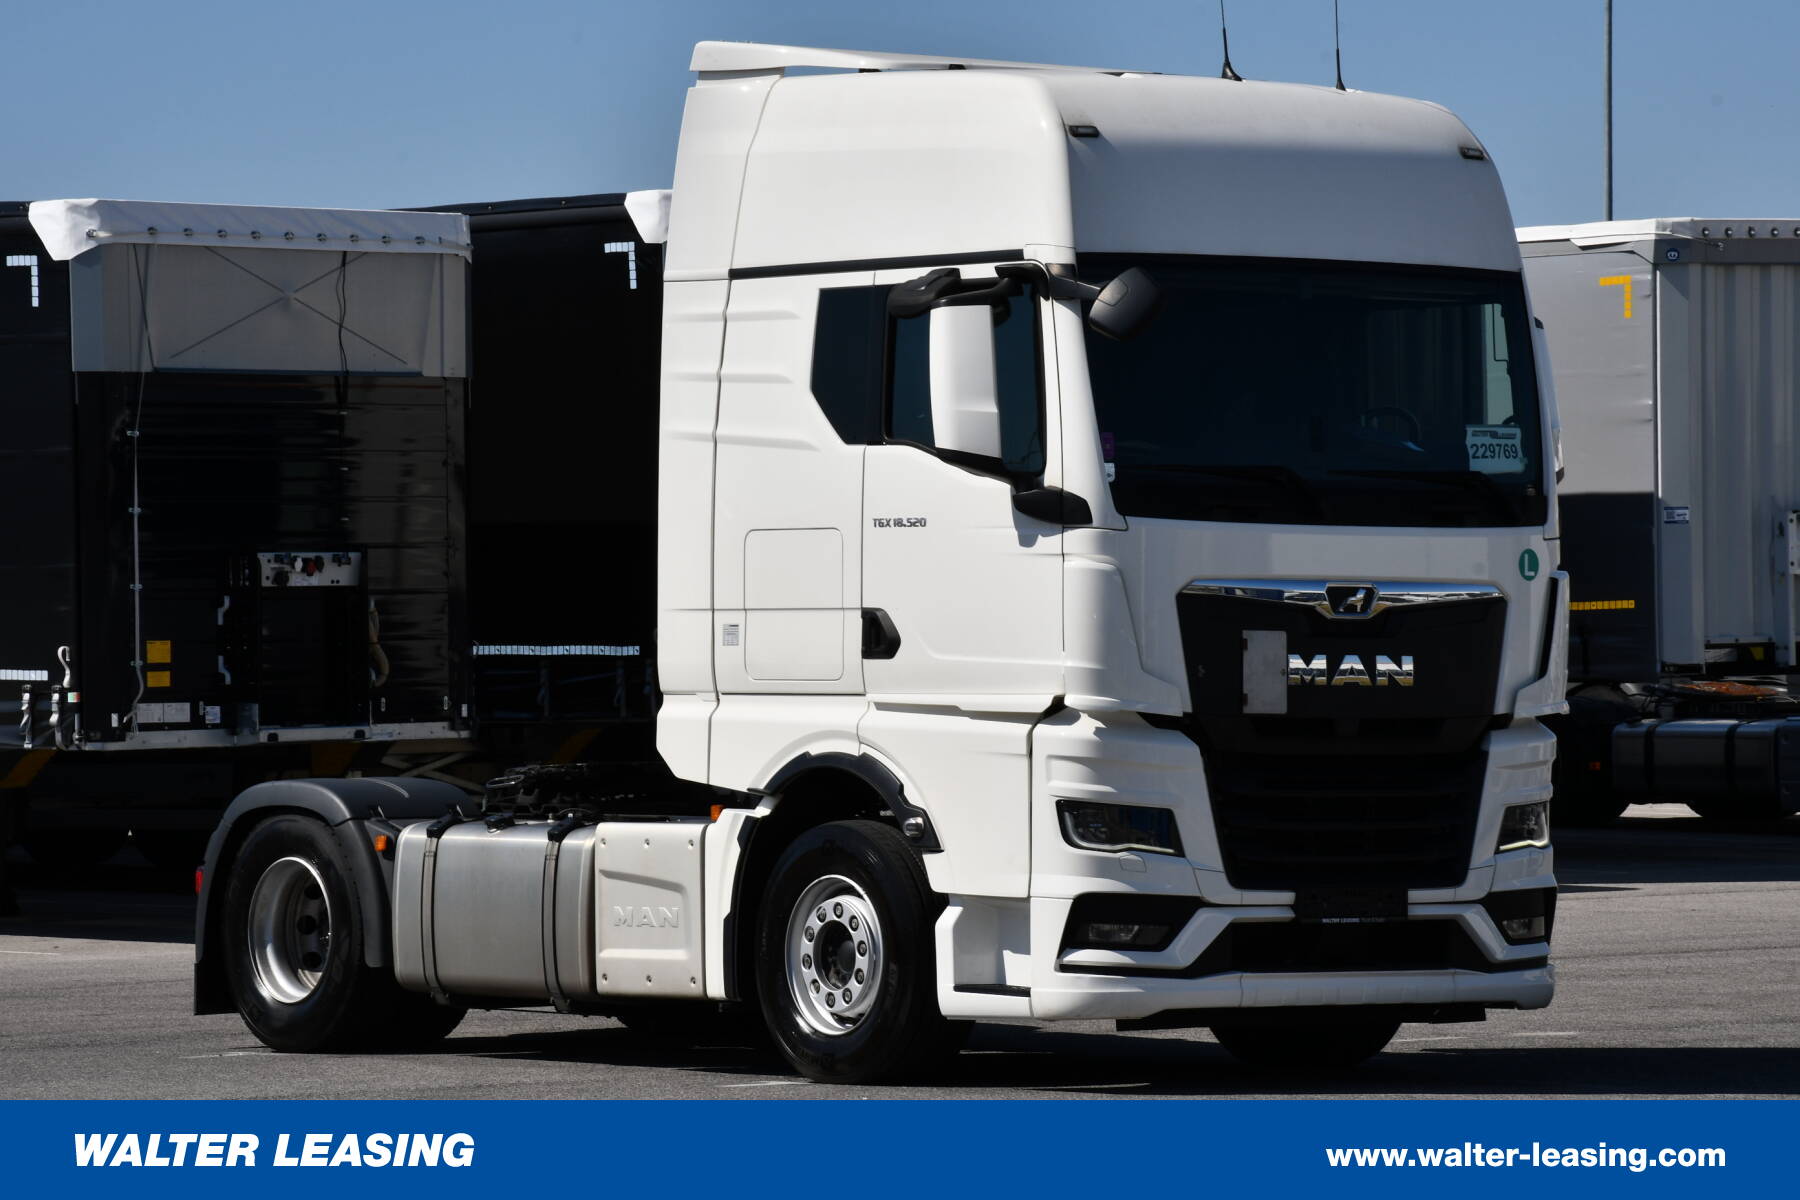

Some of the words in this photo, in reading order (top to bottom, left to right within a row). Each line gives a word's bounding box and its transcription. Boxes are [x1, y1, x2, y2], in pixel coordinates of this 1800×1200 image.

[1470, 443, 1519, 459] 229769
[873, 517, 892, 528] TGX
[893, 517, 927, 528] 18.520
[1524, 553, 1536, 577] L
[1287, 654, 1415, 687] MAN
[613, 905, 680, 928] MAN
